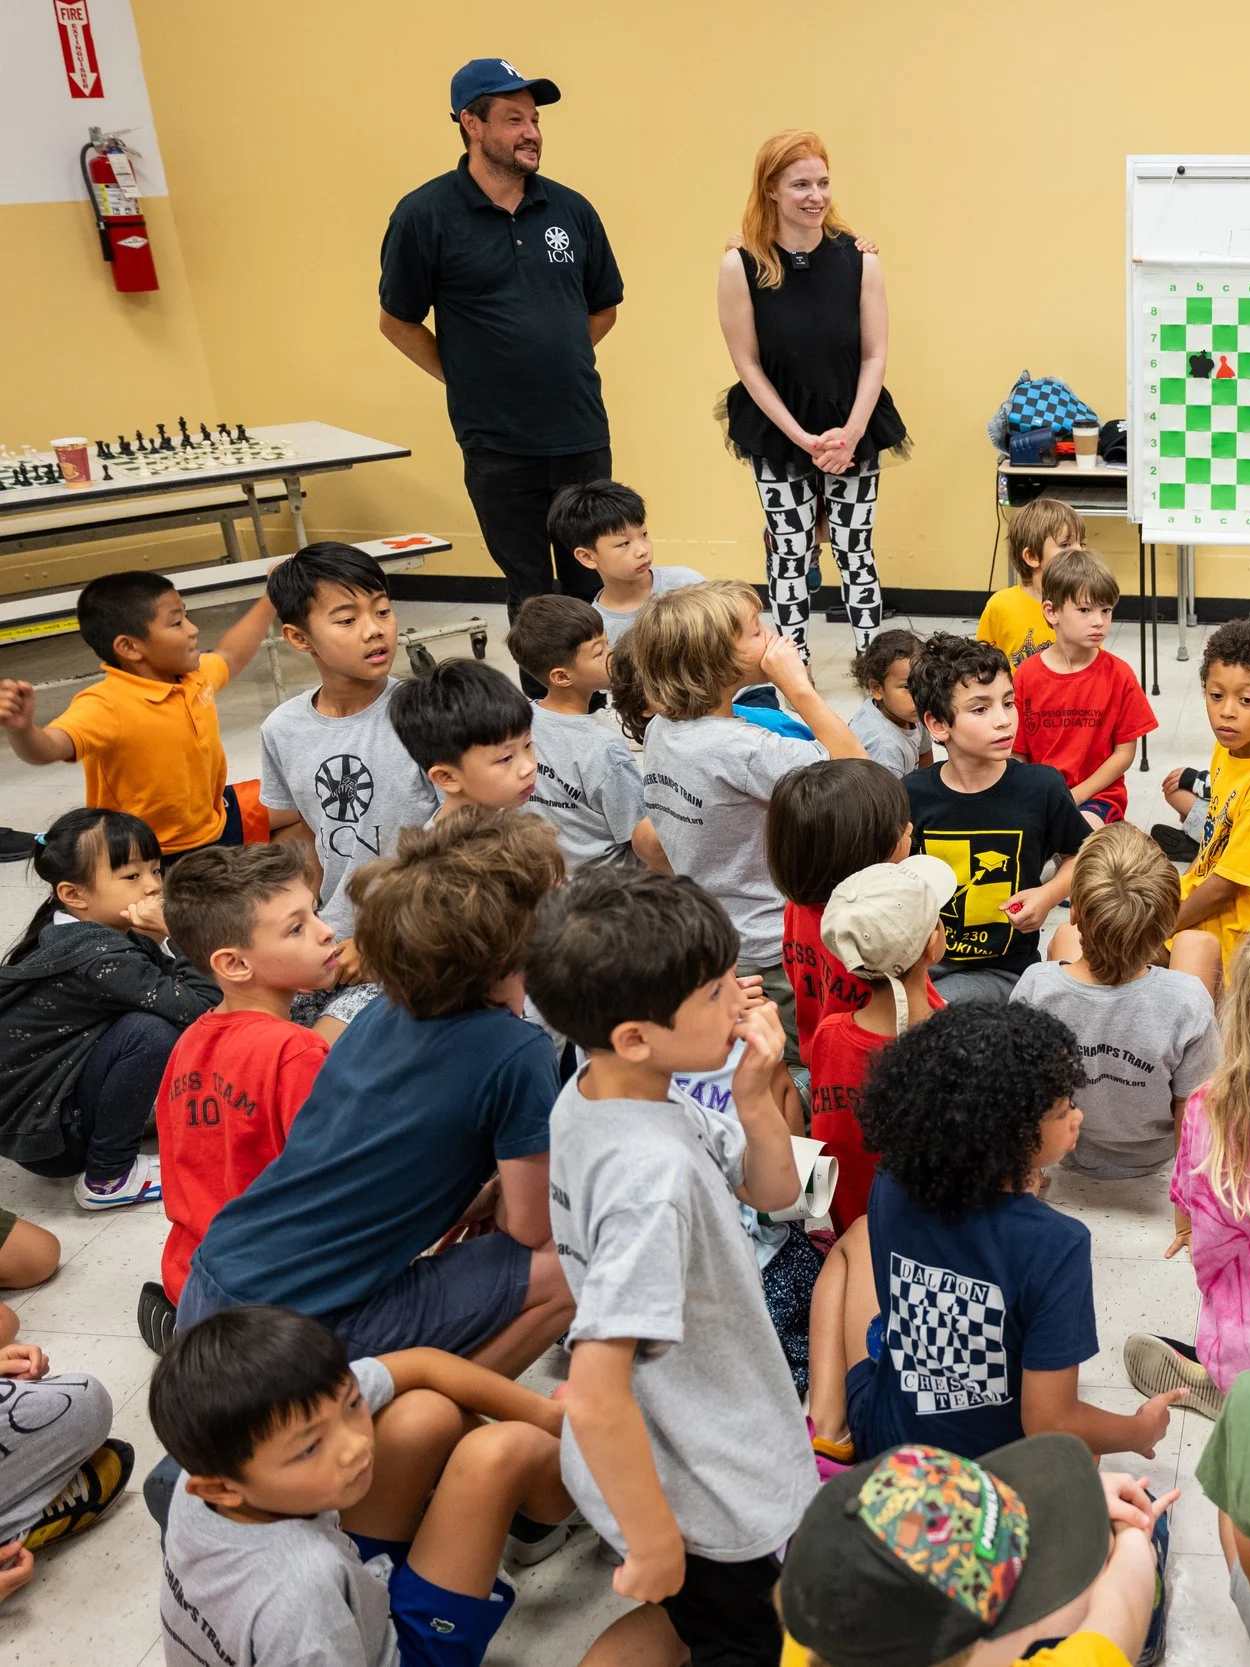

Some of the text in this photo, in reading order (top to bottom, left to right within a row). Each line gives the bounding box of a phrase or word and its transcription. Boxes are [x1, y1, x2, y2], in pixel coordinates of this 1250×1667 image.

[60, 8, 84, 21] FIRE
[71, 23, 89, 89] EXTINGUISHER
[547, 250, 575, 263] ICN
[1196, 283, 1204, 292] b
[1194, 515, 1201, 524] b
[680, 785, 703, 808] TRAIN
[963, 931, 989, 943] 230
[1077, 1043, 1156, 1074] CHAMPS TRAIN
[212, 1072, 258, 1117] TEAM
[187, 1096, 221, 1127] 10
[902, 1262, 988, 1303] DALTON
[935, 1389, 1001, 1409] TEAM
